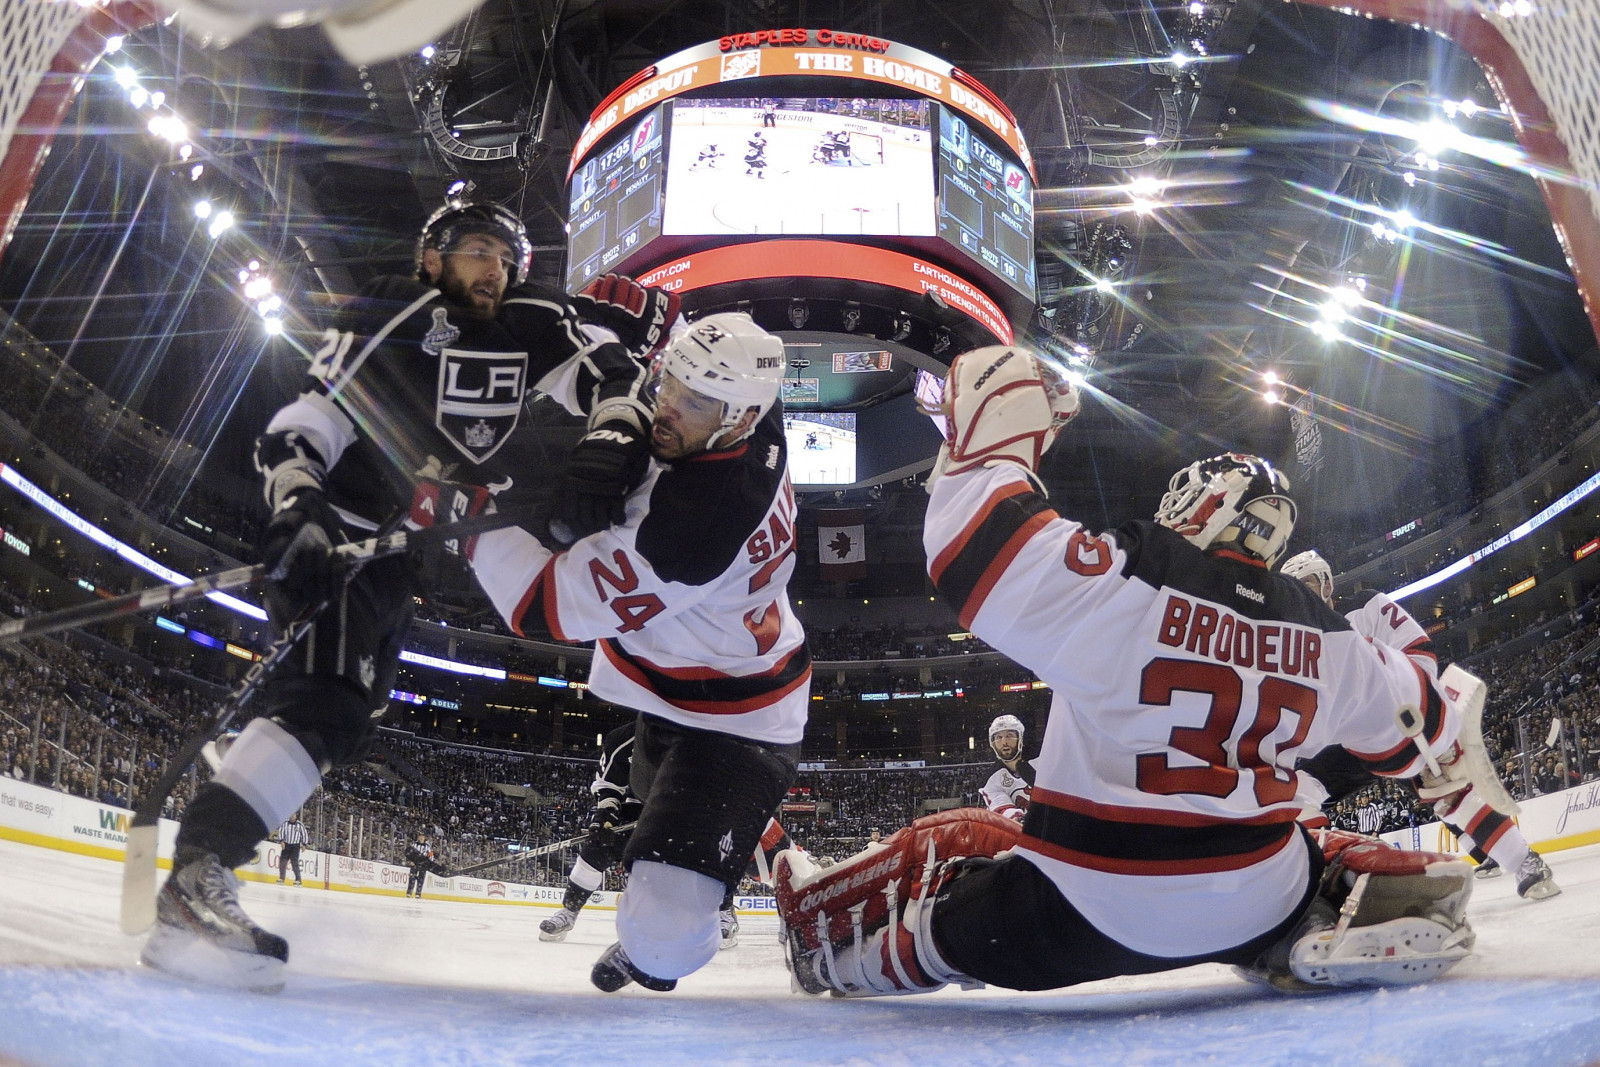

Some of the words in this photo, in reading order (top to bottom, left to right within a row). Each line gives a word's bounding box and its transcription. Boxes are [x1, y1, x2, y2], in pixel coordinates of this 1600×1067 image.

[719, 28, 807, 52] STAPLES
[817, 28, 890, 51] Center
[623, 66, 698, 115] DEPOT
[795, 52, 853, 72] THE
[863, 56, 942, 95] HOME
[950, 79, 1009, 137] DEPOT
[600, 141, 631, 172] 17:05
[973, 141, 1004, 175] 17:05
[625, 173, 650, 196] PENALTY
[953, 174, 977, 197] PENALTY
[579, 209, 601, 231] PENALTY
[1001, 211, 1023, 232] PENALTY
[625, 231, 638, 248] 10
[602, 244, 621, 262] SHOTS
[981, 245, 999, 263] SHOTS
[1003, 261, 1015, 276] 10
[920, 279, 939, 294] THE
[940, 285, 982, 317] STRENGTH
[673, 348, 699, 369] CCM
[449, 362, 522, 399] LA
[765, 443, 780, 470] Reebok
[1391, 520, 1416, 539] STAPLES
[3, 531, 30, 556] TOYOTA
[588, 549, 666, 634] 24
[1235, 583, 1265, 604] Reebok
[1381, 602, 1409, 631] 2
[1156, 594, 1322, 680] BRODEUR
[438, 700, 459, 711] DELTA
[1135, 656, 1319, 807] 30
[1, 792, 17, 807] that
[18, 798, 33, 811] was
[73, 825, 102, 839] WASTE
